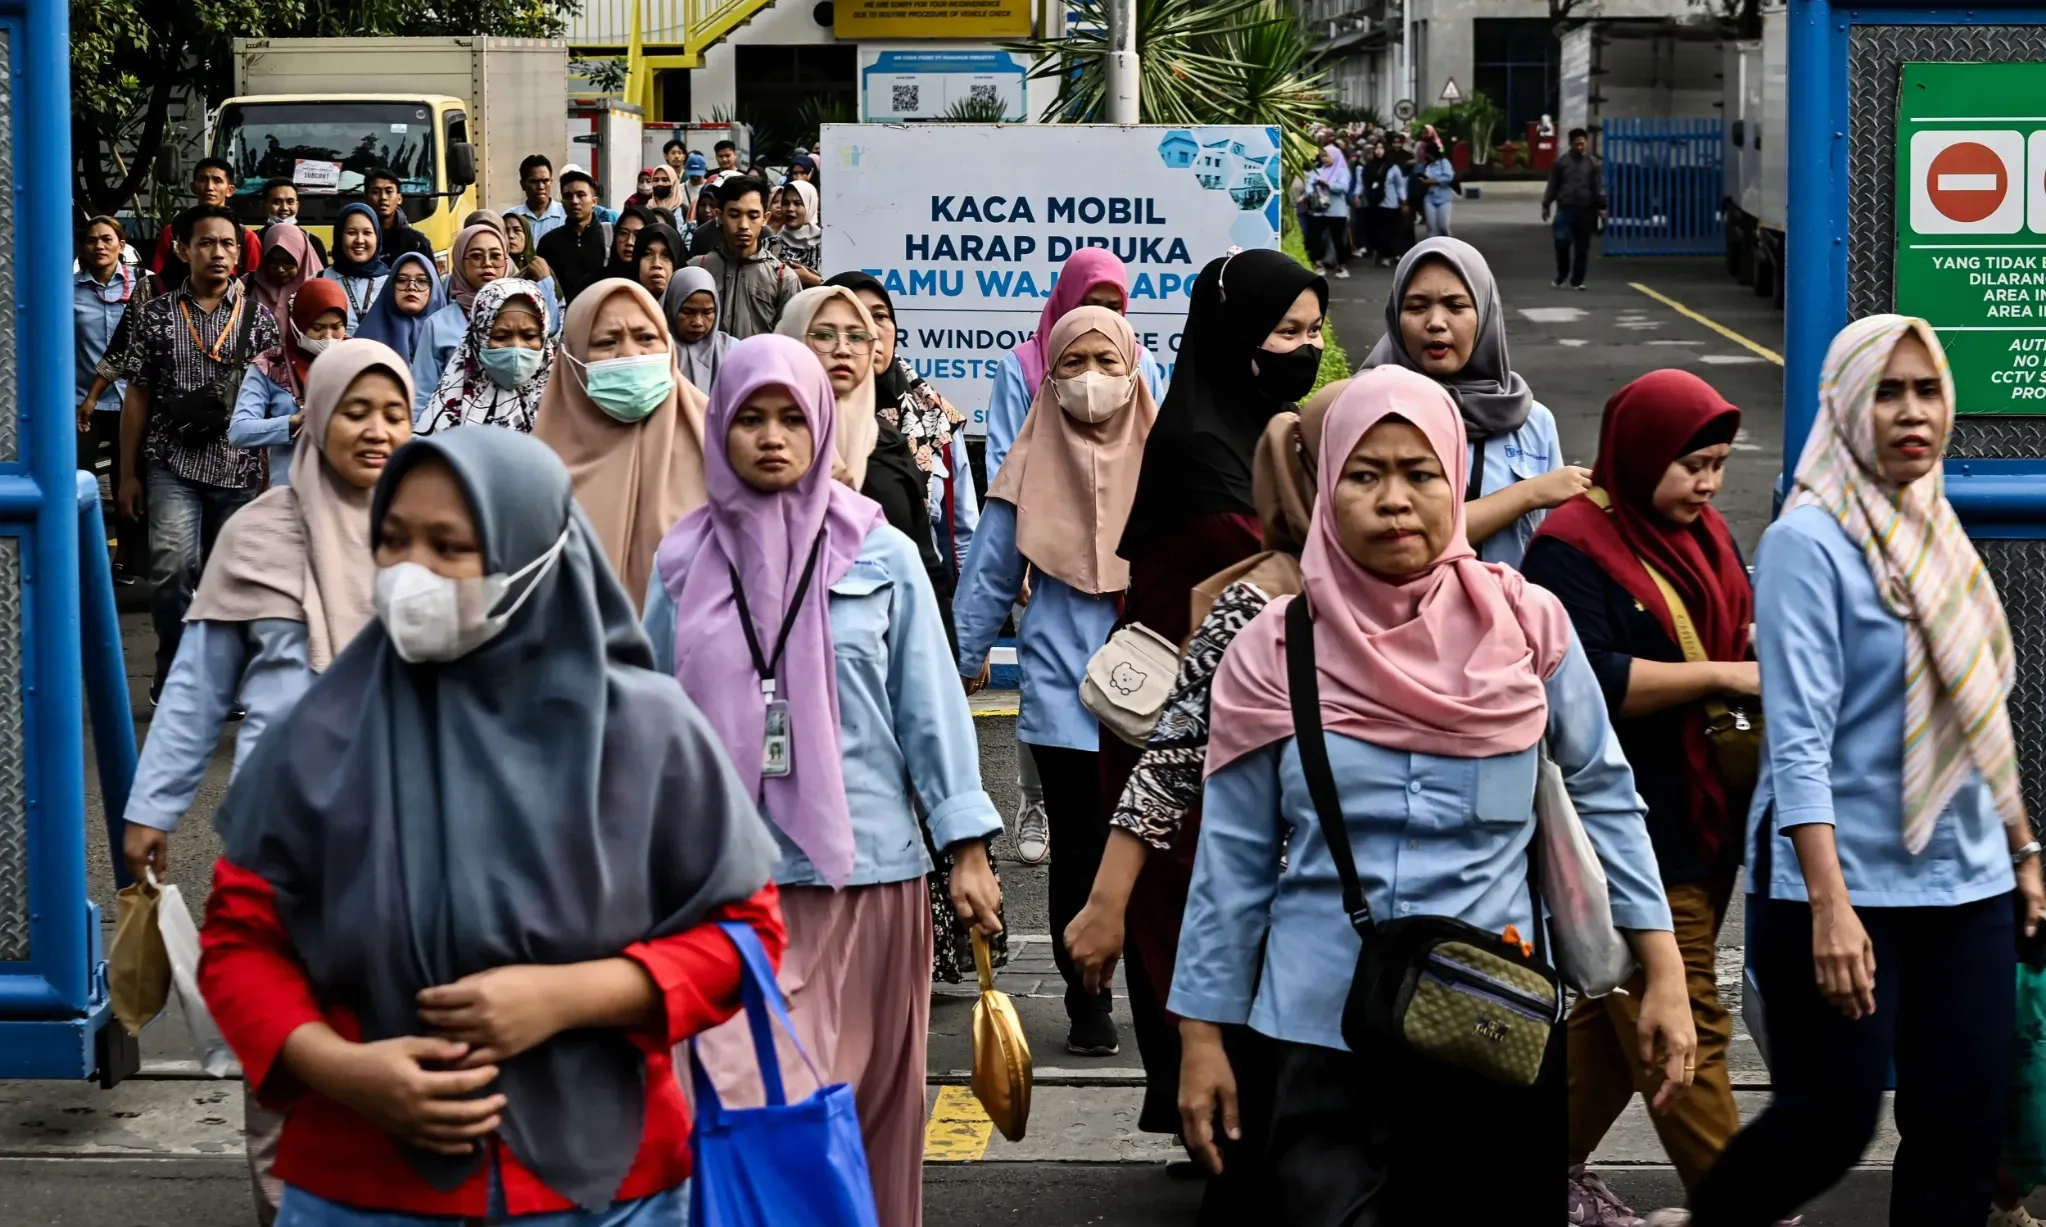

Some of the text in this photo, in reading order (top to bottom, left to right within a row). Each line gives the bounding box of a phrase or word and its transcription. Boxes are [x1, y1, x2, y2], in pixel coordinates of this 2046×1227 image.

[931, 195, 1166, 225] KACA MOBIL
[905, 234, 1036, 262] HARAP
[1932, 257, 1981, 269] YANG
[1985, 257, 2037, 269] TIDAK
[1969, 273, 2046, 285] DILARAN
[1983, 289, 2030, 301] AREA
[1987, 305, 2033, 317] AREA
[2008, 338, 2046, 351] AUT
[2013, 355, 2040, 367] NO
[1991, 371, 2037, 383] CCTV
